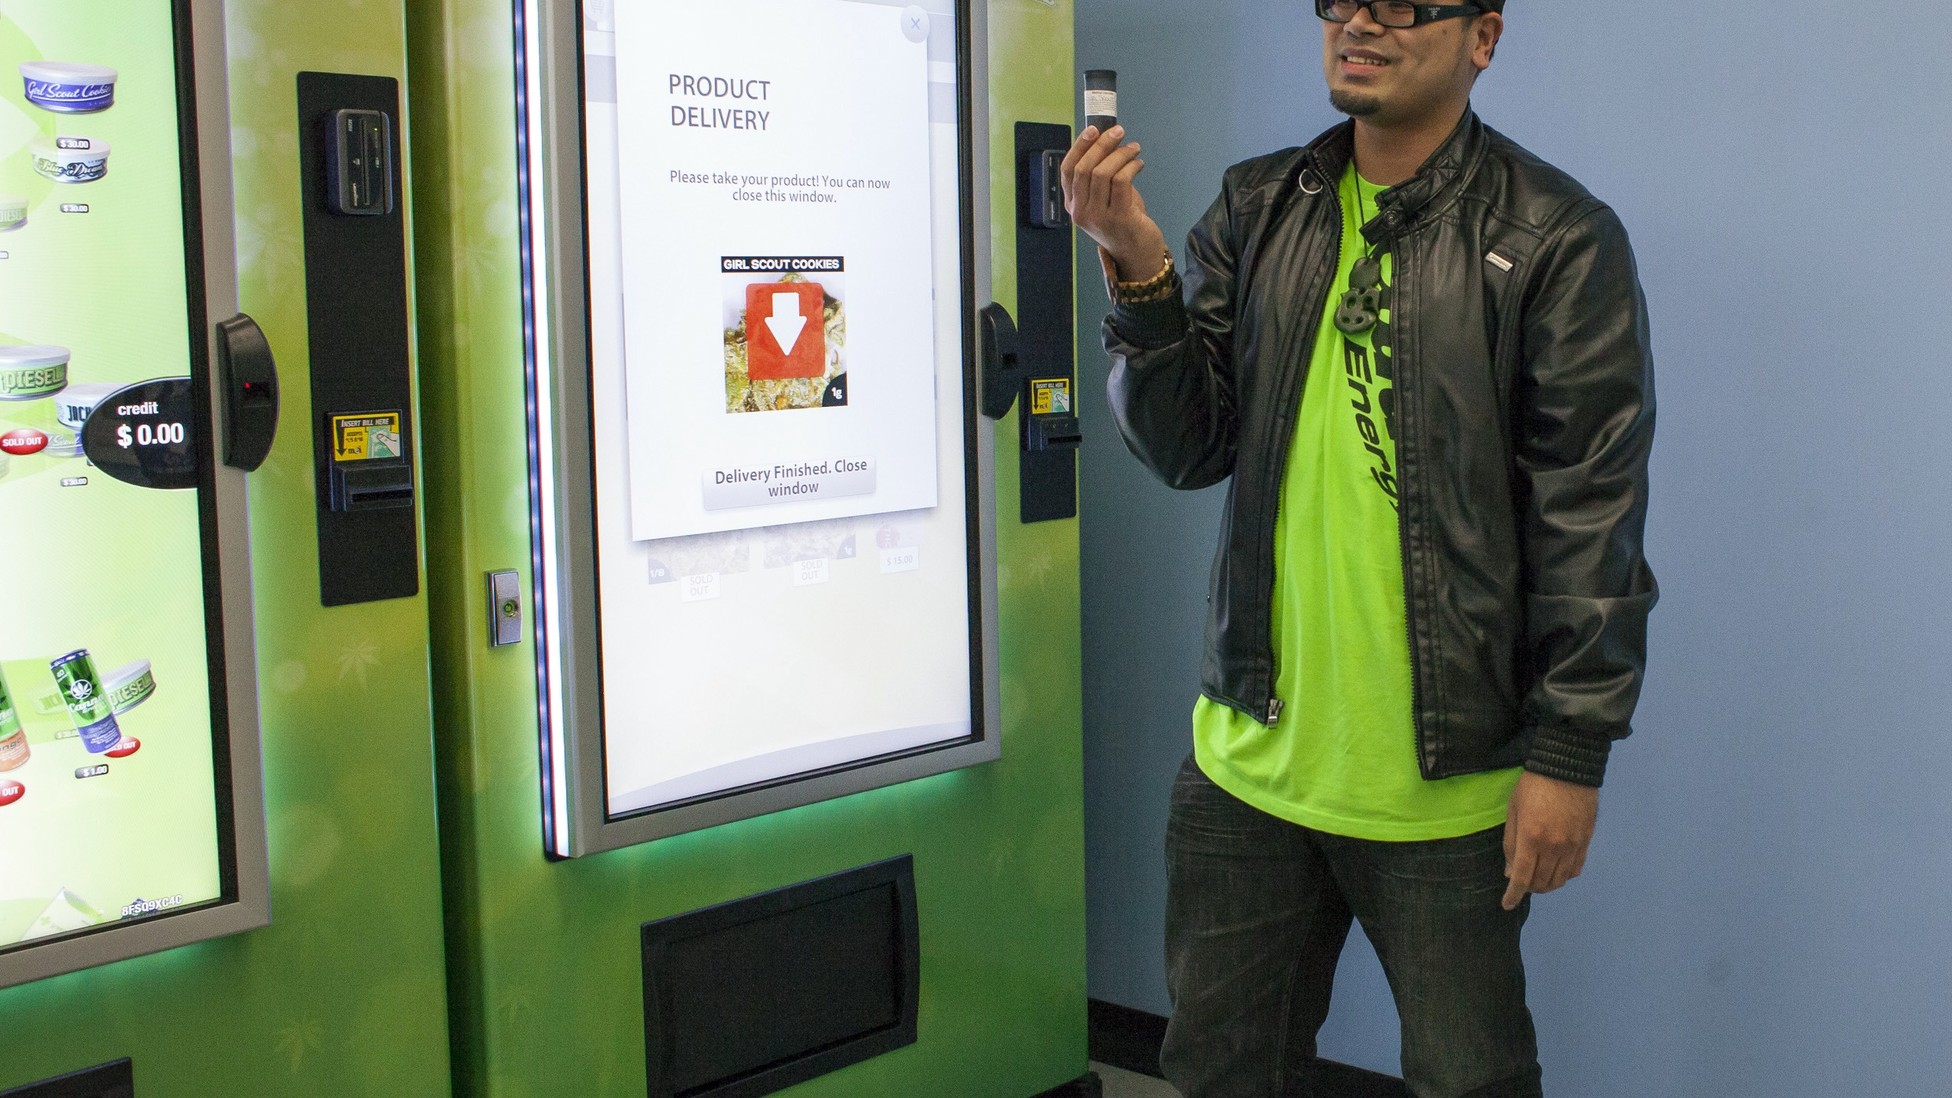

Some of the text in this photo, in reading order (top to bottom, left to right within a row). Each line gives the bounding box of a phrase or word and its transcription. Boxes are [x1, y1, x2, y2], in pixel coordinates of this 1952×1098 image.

[28, 81, 43, 98] Girl
[47, 83, 80, 98] Scout
[669, 74, 771, 100] PRODUCT
[671, 105, 770, 131] DELIVERY
[59, 139, 89, 149] $ 30.00
[40, 158, 64, 175] Blue
[670, 170, 891, 189] Please take your product! You can now
[732, 188, 837, 203] close this window.
[724, 259, 840, 270] GIRL SCOUT COOKIES
[6, 368, 63, 389] DIESEL
[831, 387, 842, 400] 1g
[117, 401, 159, 416] credit
[341, 419, 361, 428] INSERT
[362, 418, 374, 426] BILL
[117, 422, 184, 448] $ 0.00
[3, 438, 25, 447] SOLD
[26, 436, 42, 446] OUT
[715, 459, 868, 485] Delivery Finished. Close
[768, 481, 819, 497] window
[800, 560, 823, 572] SOLD
[886, 555, 913, 567] $ 15.00
[650, 567, 665, 578] 1/8
[801, 570, 818, 581] OUT
[689, 574, 713, 586] SOLD
[690, 585, 710, 597] OUT
[124, 741, 136, 749] OUT
[91, 766, 107, 775] 1.00
[2, 786, 19, 796] OUT
